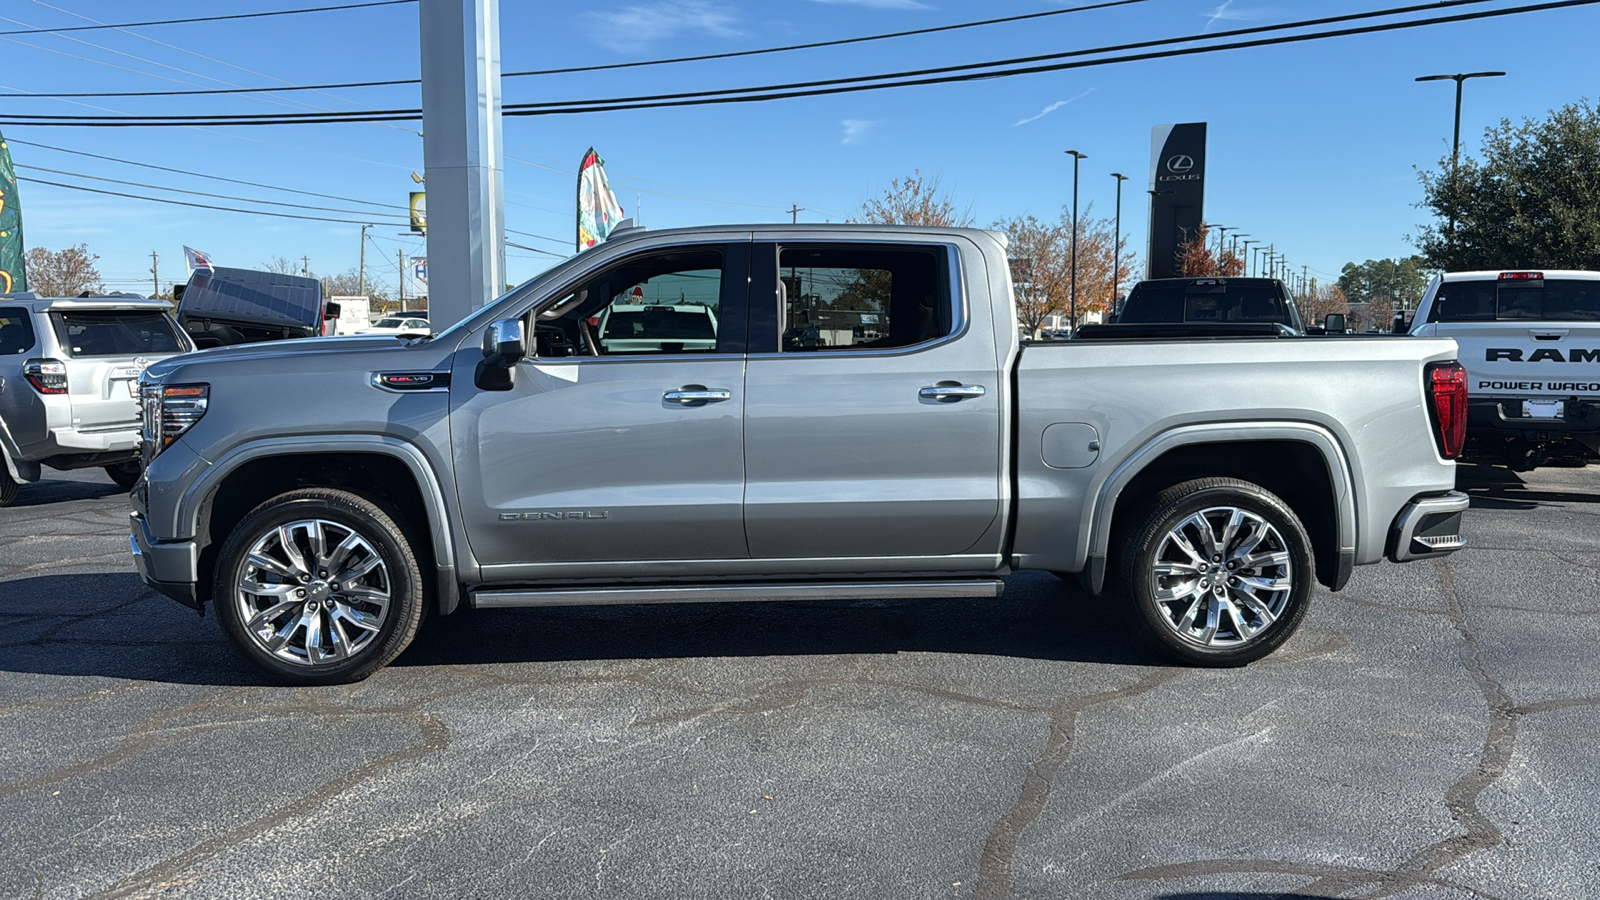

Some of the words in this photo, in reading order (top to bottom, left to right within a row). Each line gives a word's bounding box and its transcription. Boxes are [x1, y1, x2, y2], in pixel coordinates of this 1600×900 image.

[1486, 348, 1600, 363] RAM
[1479, 381, 1543, 391] POWER
[499, 510, 609, 521] DENALI
